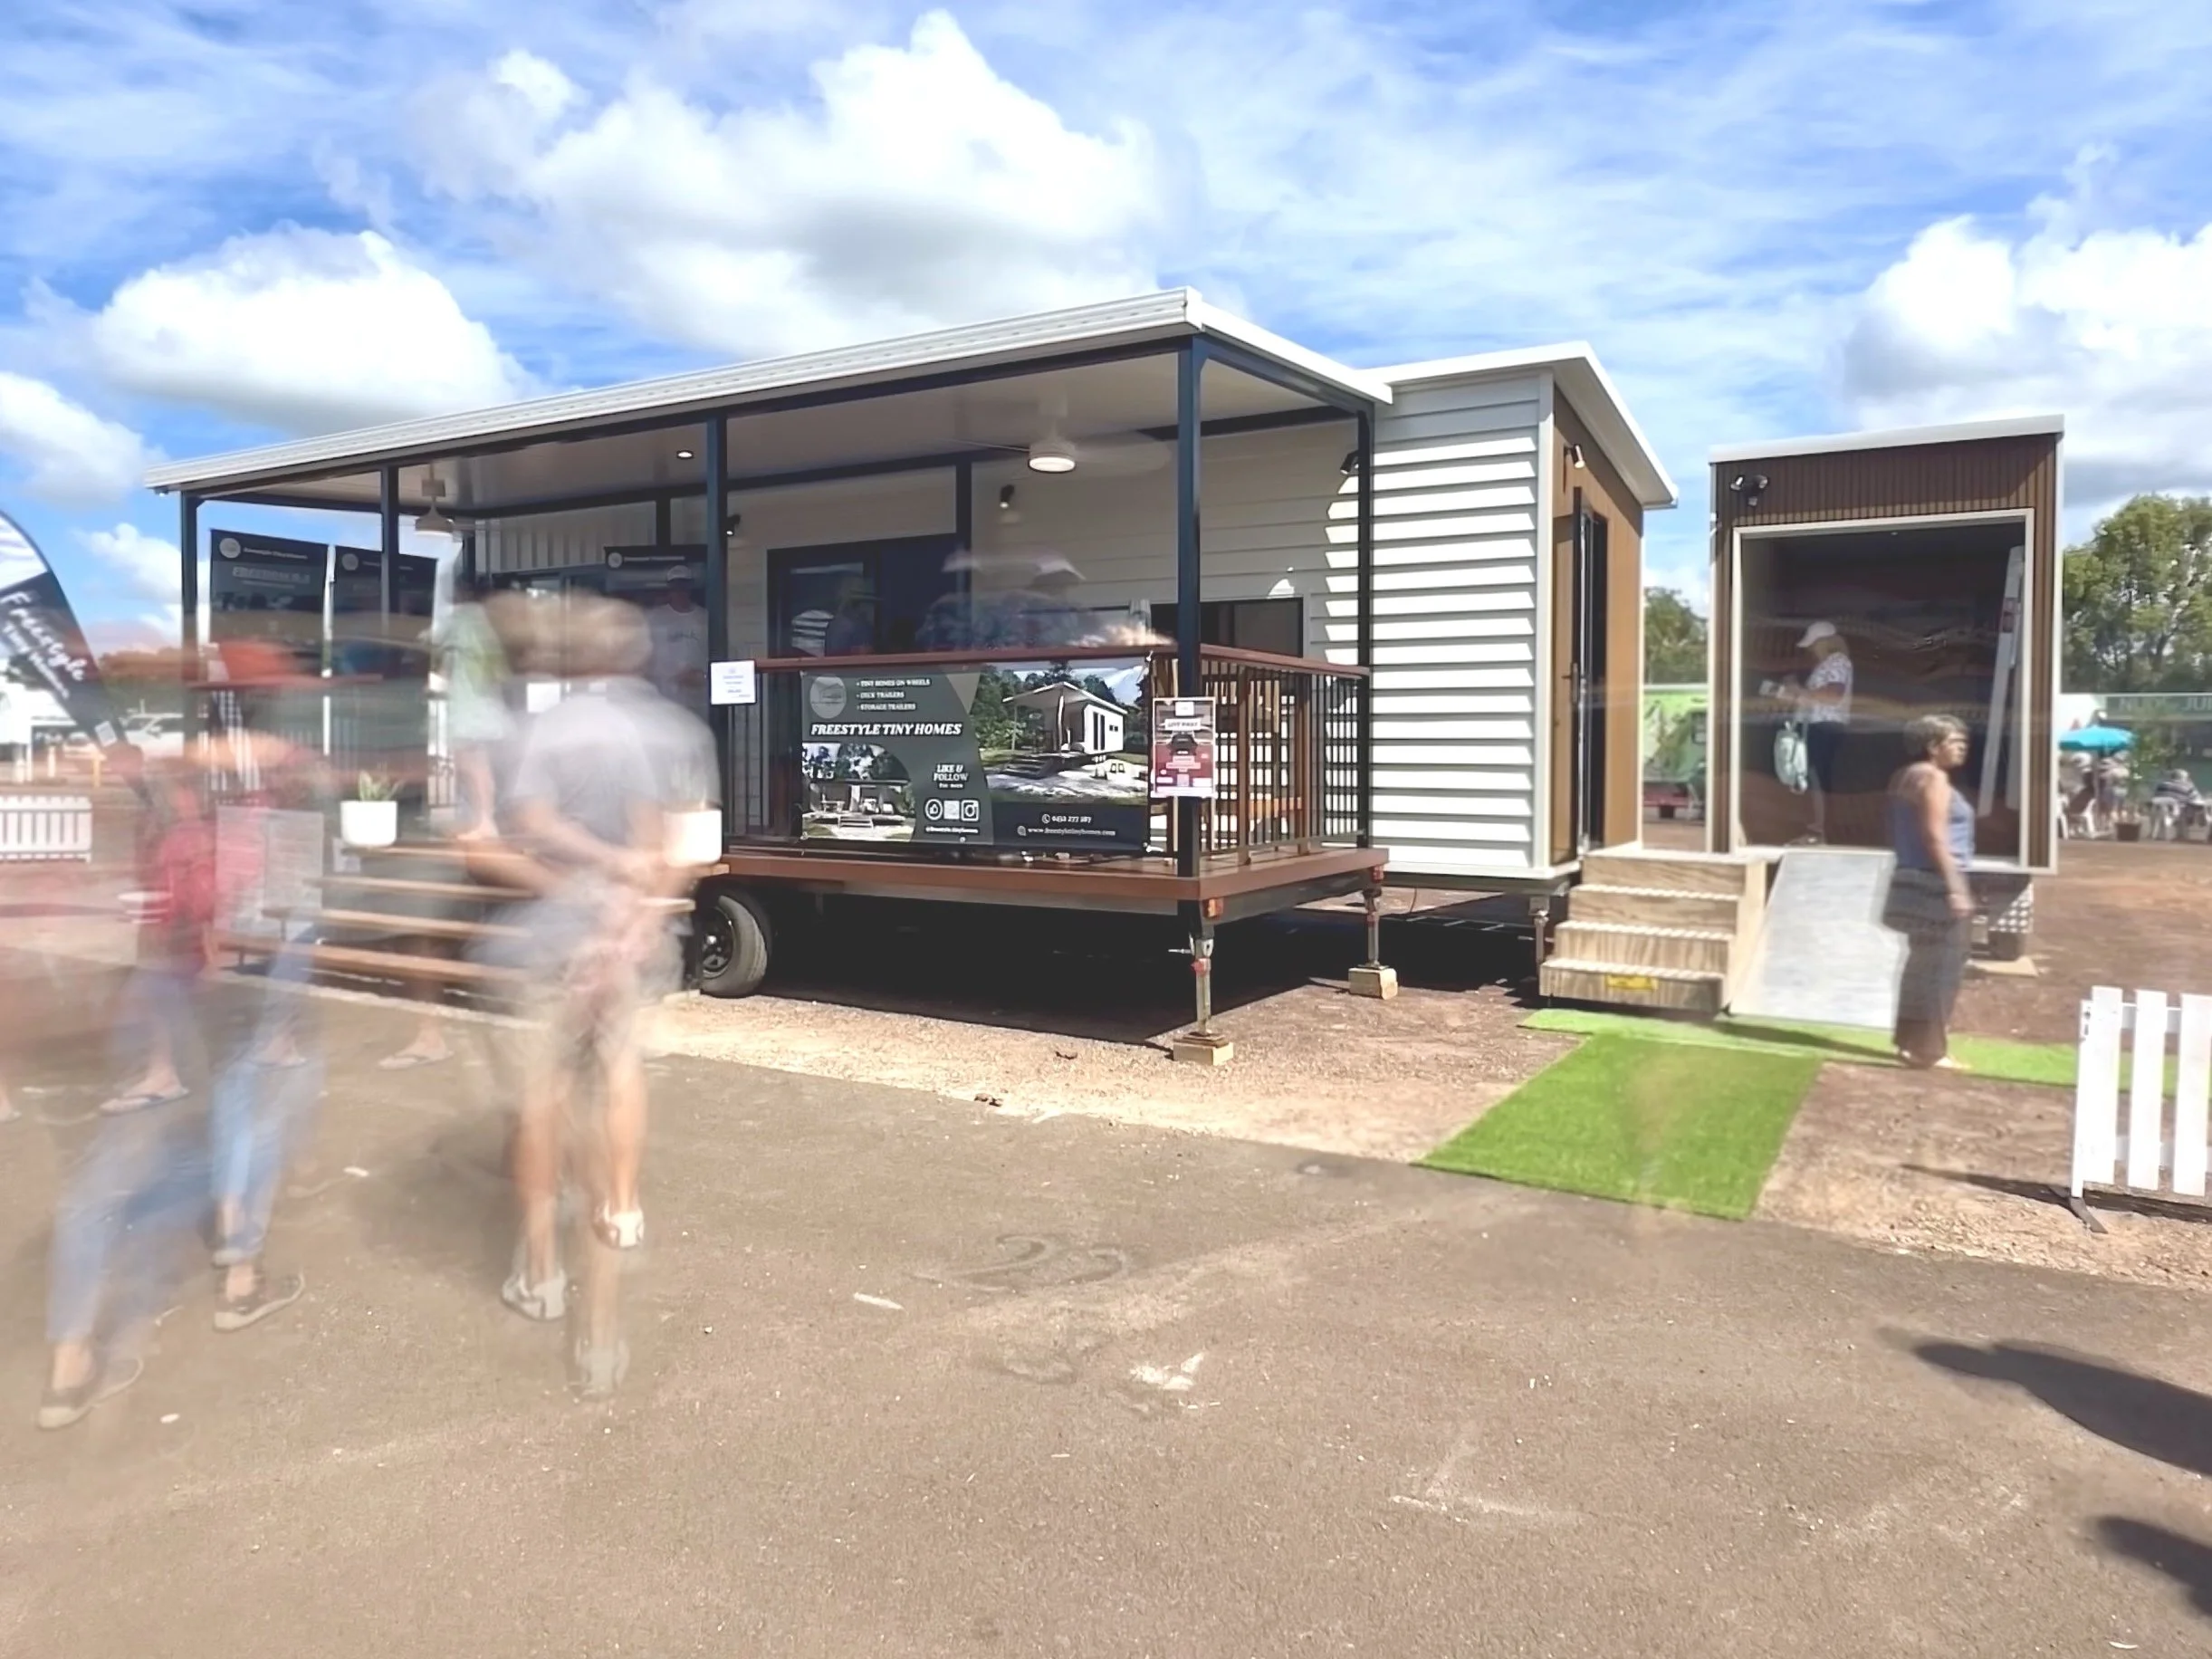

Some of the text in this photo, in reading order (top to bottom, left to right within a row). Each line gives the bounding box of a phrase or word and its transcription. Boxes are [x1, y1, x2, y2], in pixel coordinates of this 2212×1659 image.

[811, 724, 962, 735] FREESTYLE TINY HOMES
[936, 764, 954, 772] LIKE
[934, 772, 969, 782] FOLLOW
